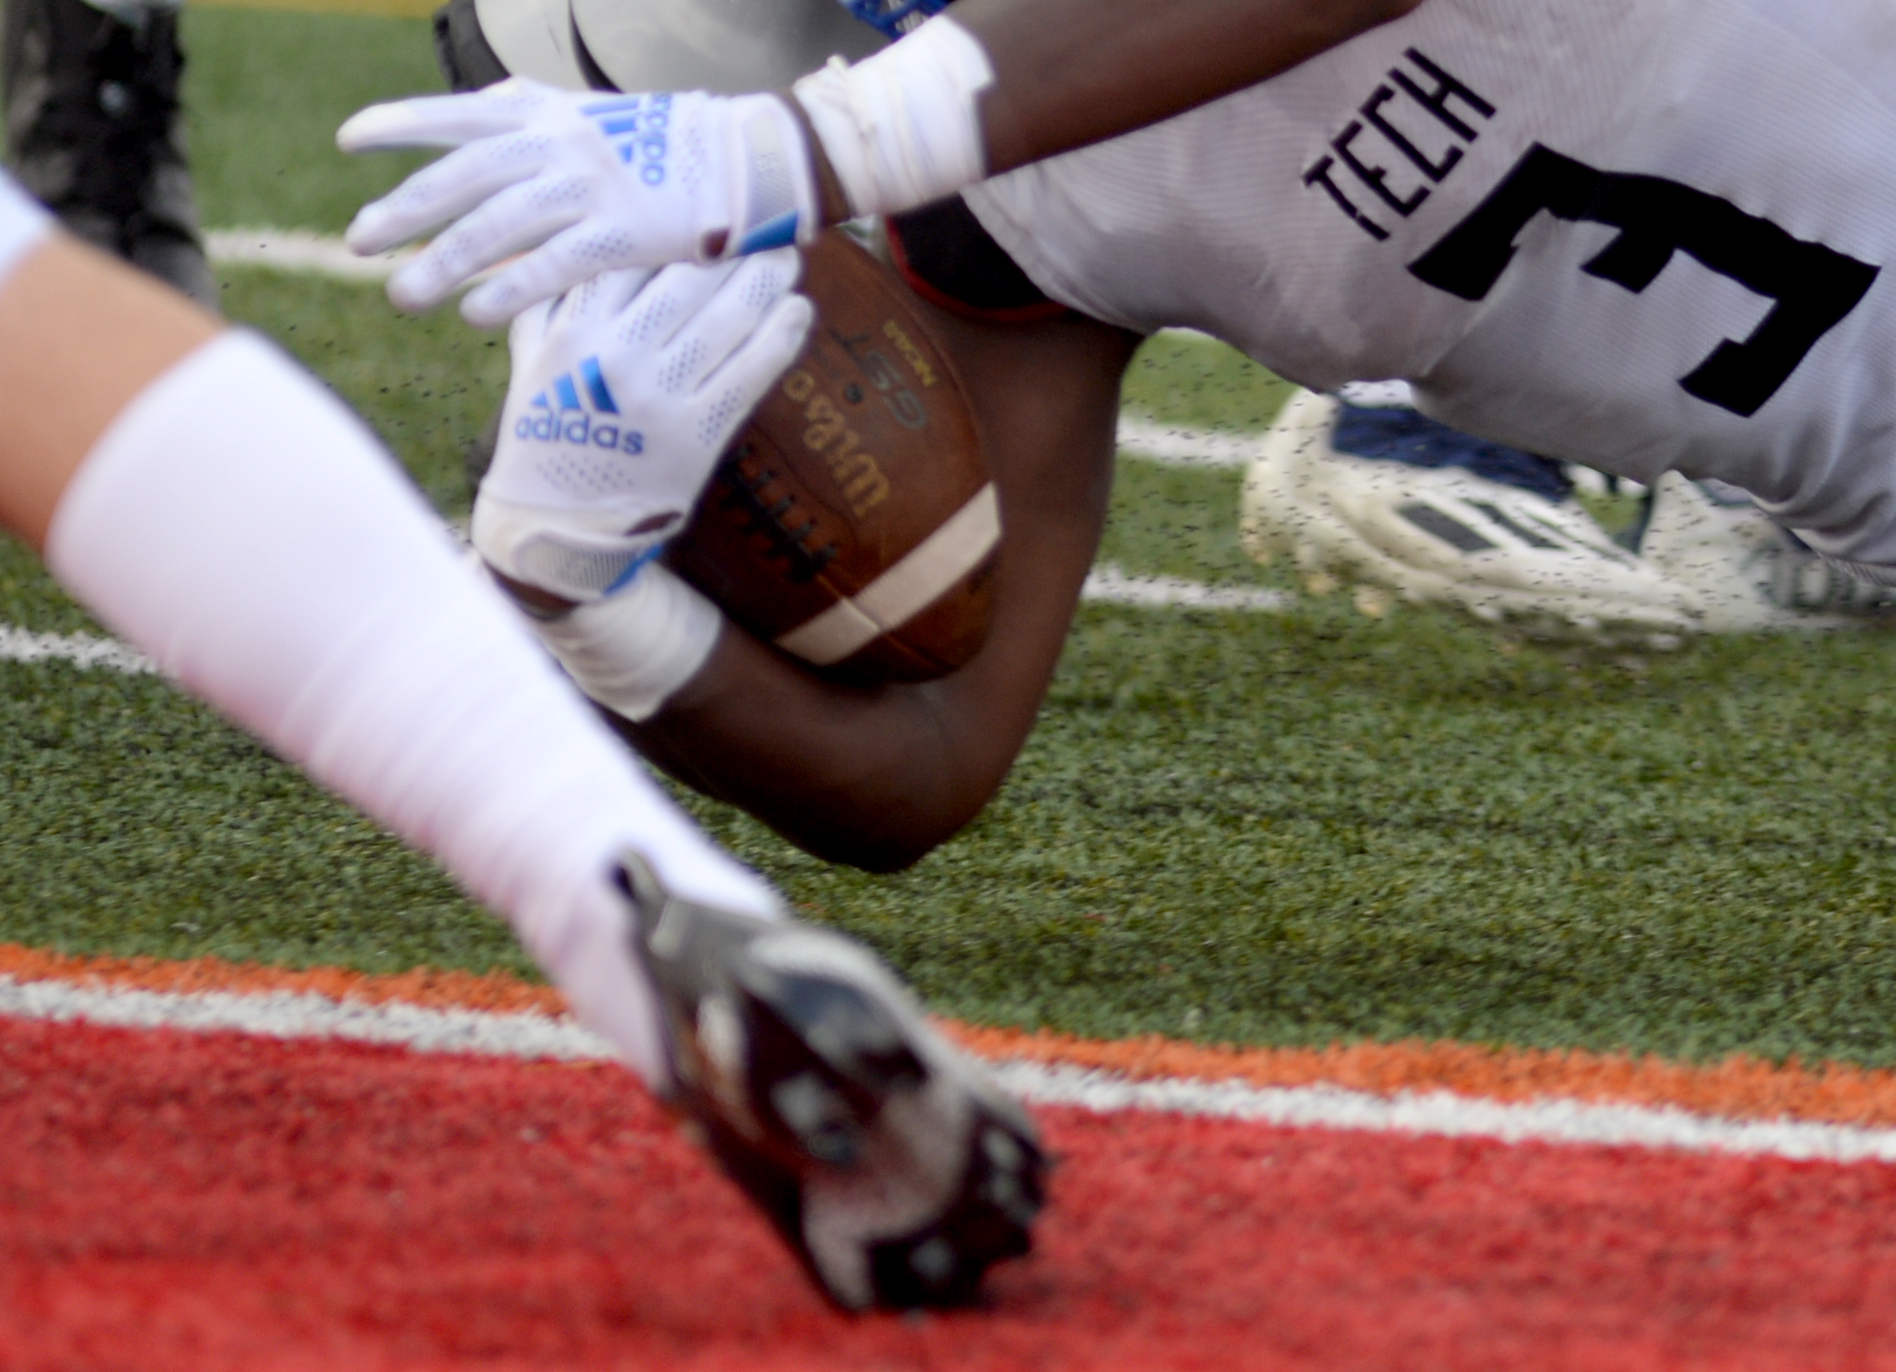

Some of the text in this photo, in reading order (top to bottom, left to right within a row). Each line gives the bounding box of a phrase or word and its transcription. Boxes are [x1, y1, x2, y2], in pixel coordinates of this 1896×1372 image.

[1302, 46, 1497, 241] TECH
[1405, 140, 1882, 418] 3
[515, 409, 644, 456] adidas
[782, 368, 890, 518] Wilso
